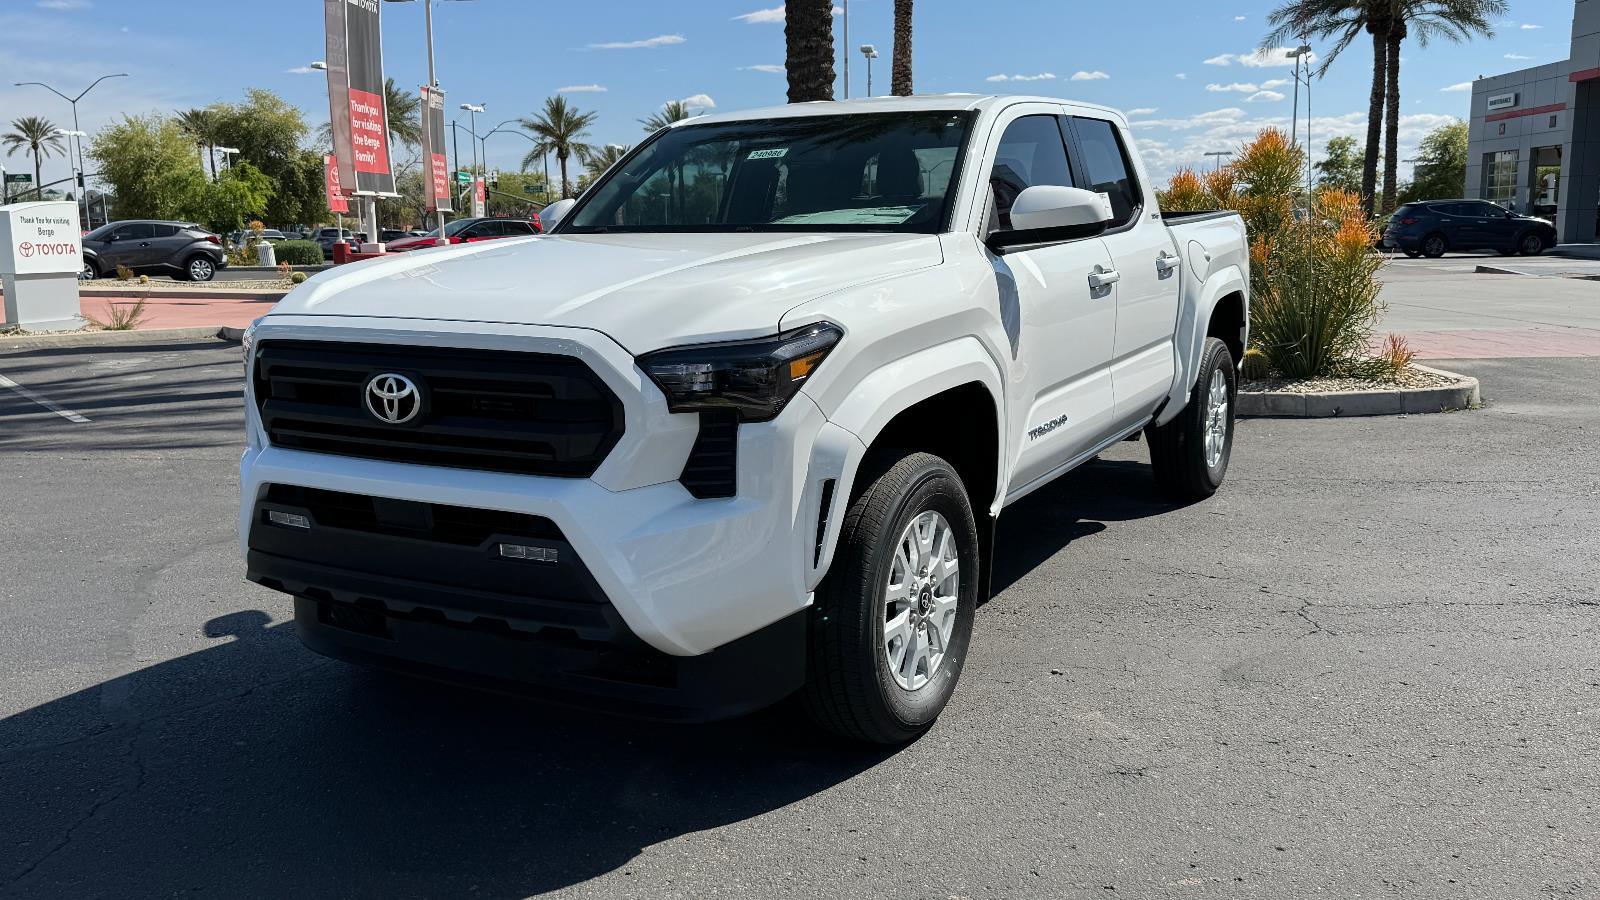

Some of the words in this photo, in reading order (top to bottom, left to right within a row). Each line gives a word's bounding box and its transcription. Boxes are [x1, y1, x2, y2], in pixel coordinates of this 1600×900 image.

[351, 100, 369, 114] Thank
[369, 107, 379, 117] you
[353, 116, 361, 128] for
[362, 118, 382, 135] visiting
[354, 133, 364, 146] the
[363, 135, 380, 150] Berge
[355, 150, 376, 165] Family!
[20, 216, 34, 224] Thank
[36, 216, 45, 224] You
[53, 217, 70, 226] visiting
[38, 227, 54, 237] Berge
[36, 244, 76, 255] TOYOTA
[1028, 414, 1068, 441] TACOMA
